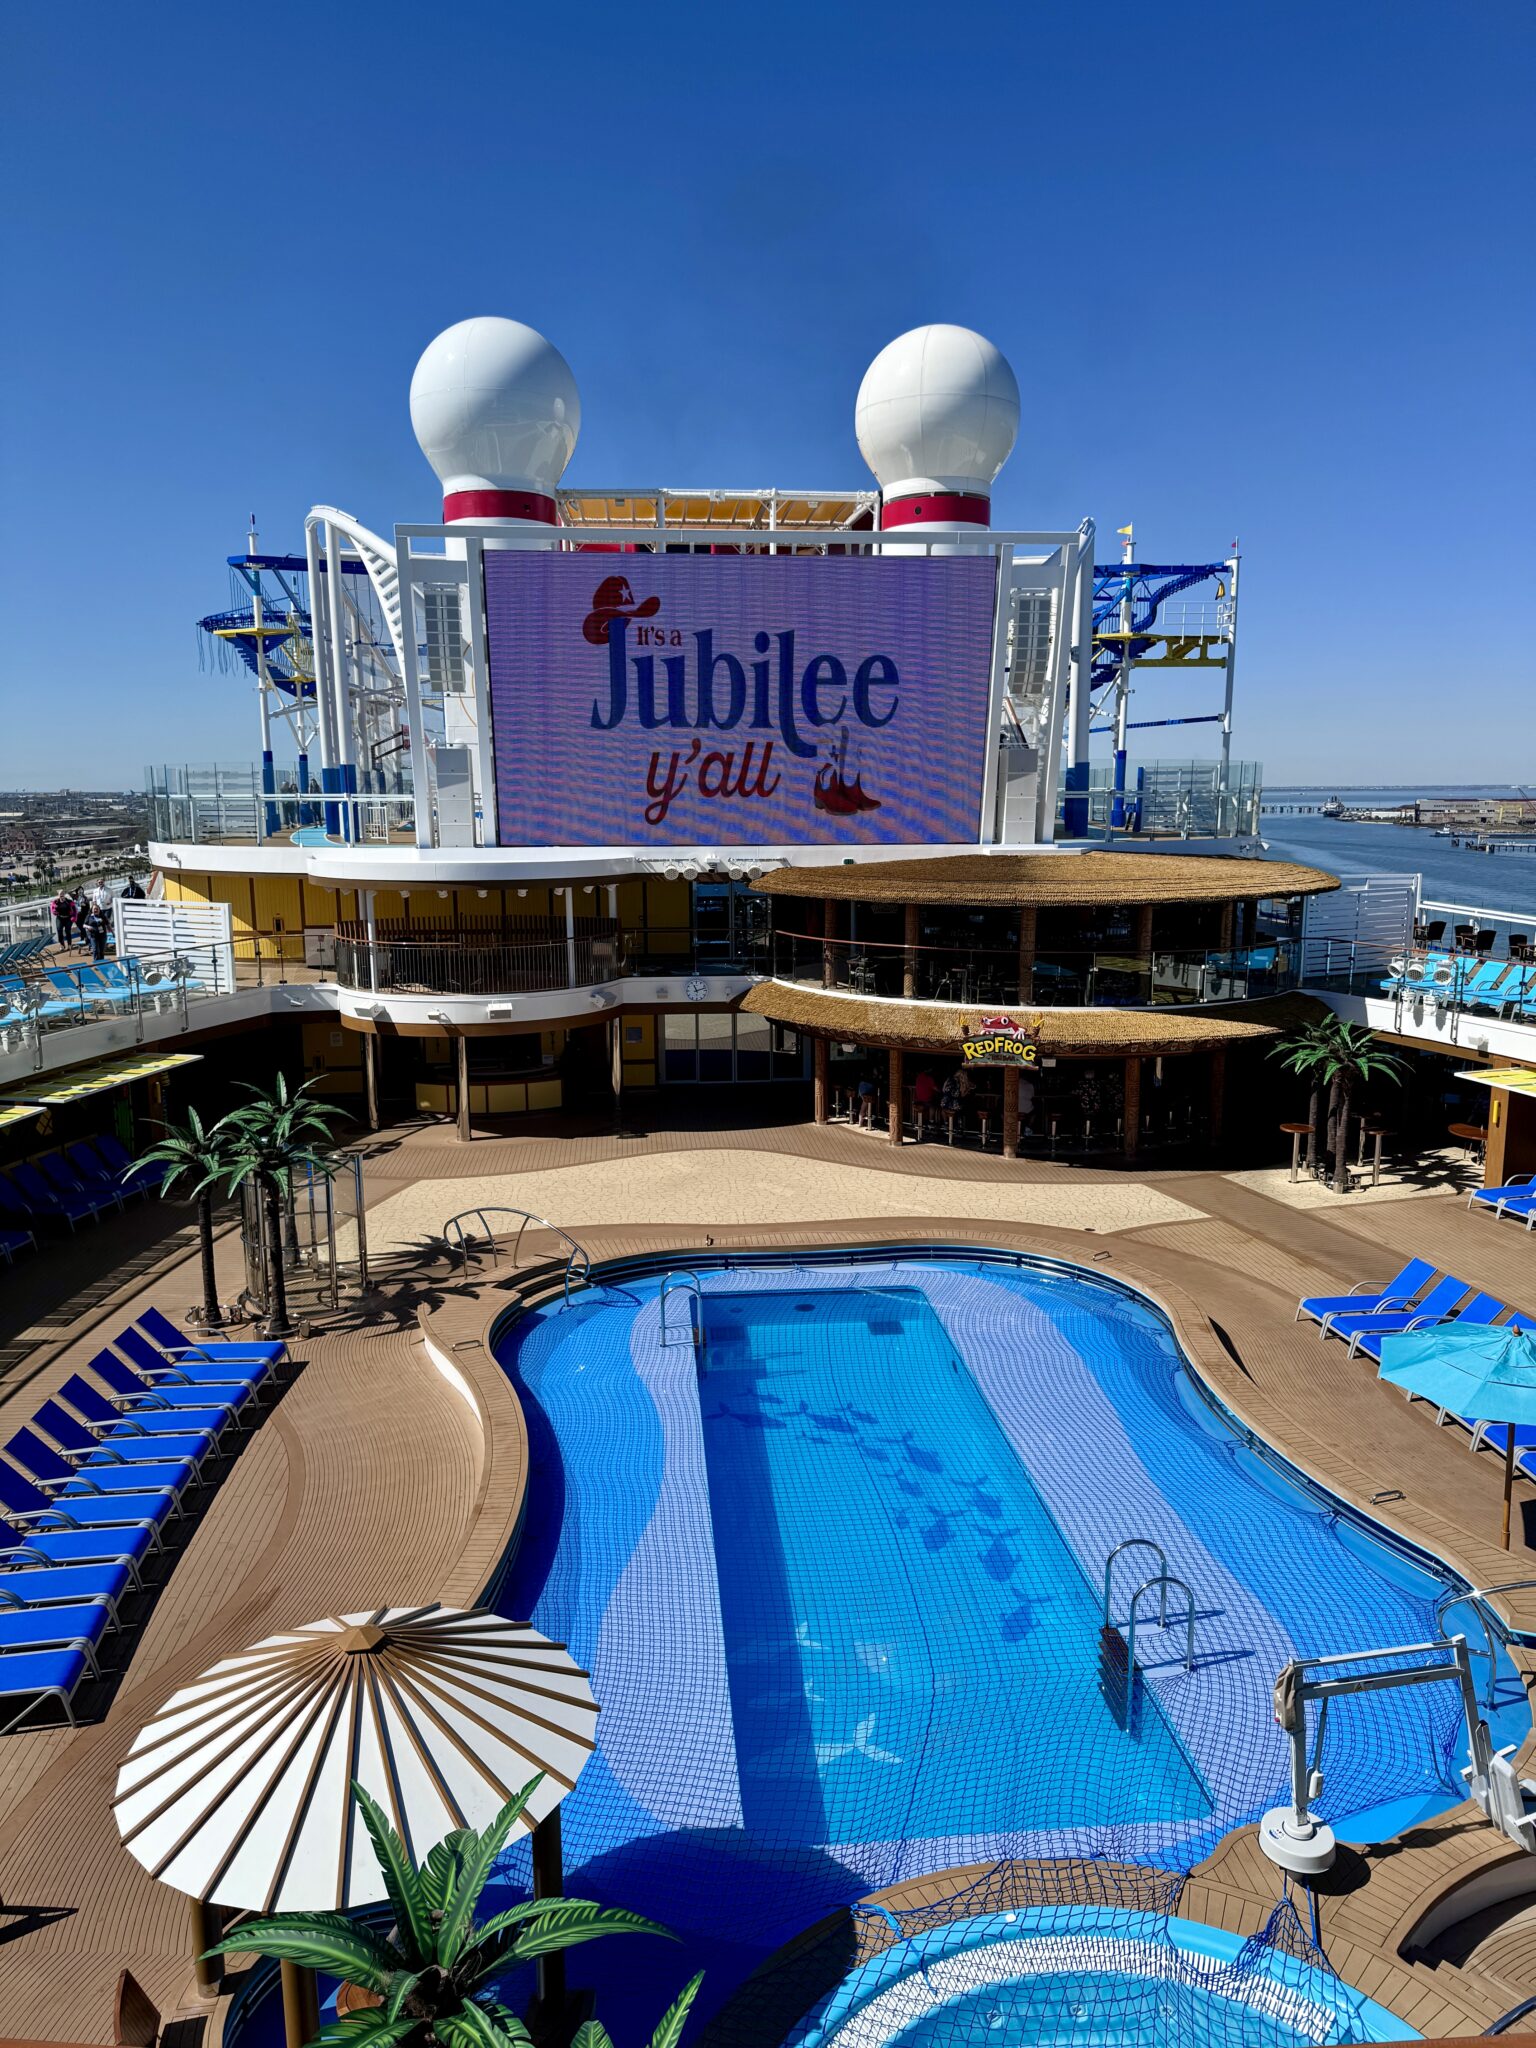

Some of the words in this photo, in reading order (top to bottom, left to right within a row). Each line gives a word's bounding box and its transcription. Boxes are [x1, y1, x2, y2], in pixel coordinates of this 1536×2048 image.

[636, 626, 666, 647] It's
[670, 629, 683, 647] a
[590, 616, 899, 759] Jubilee
[644, 737, 781, 826] y'all
